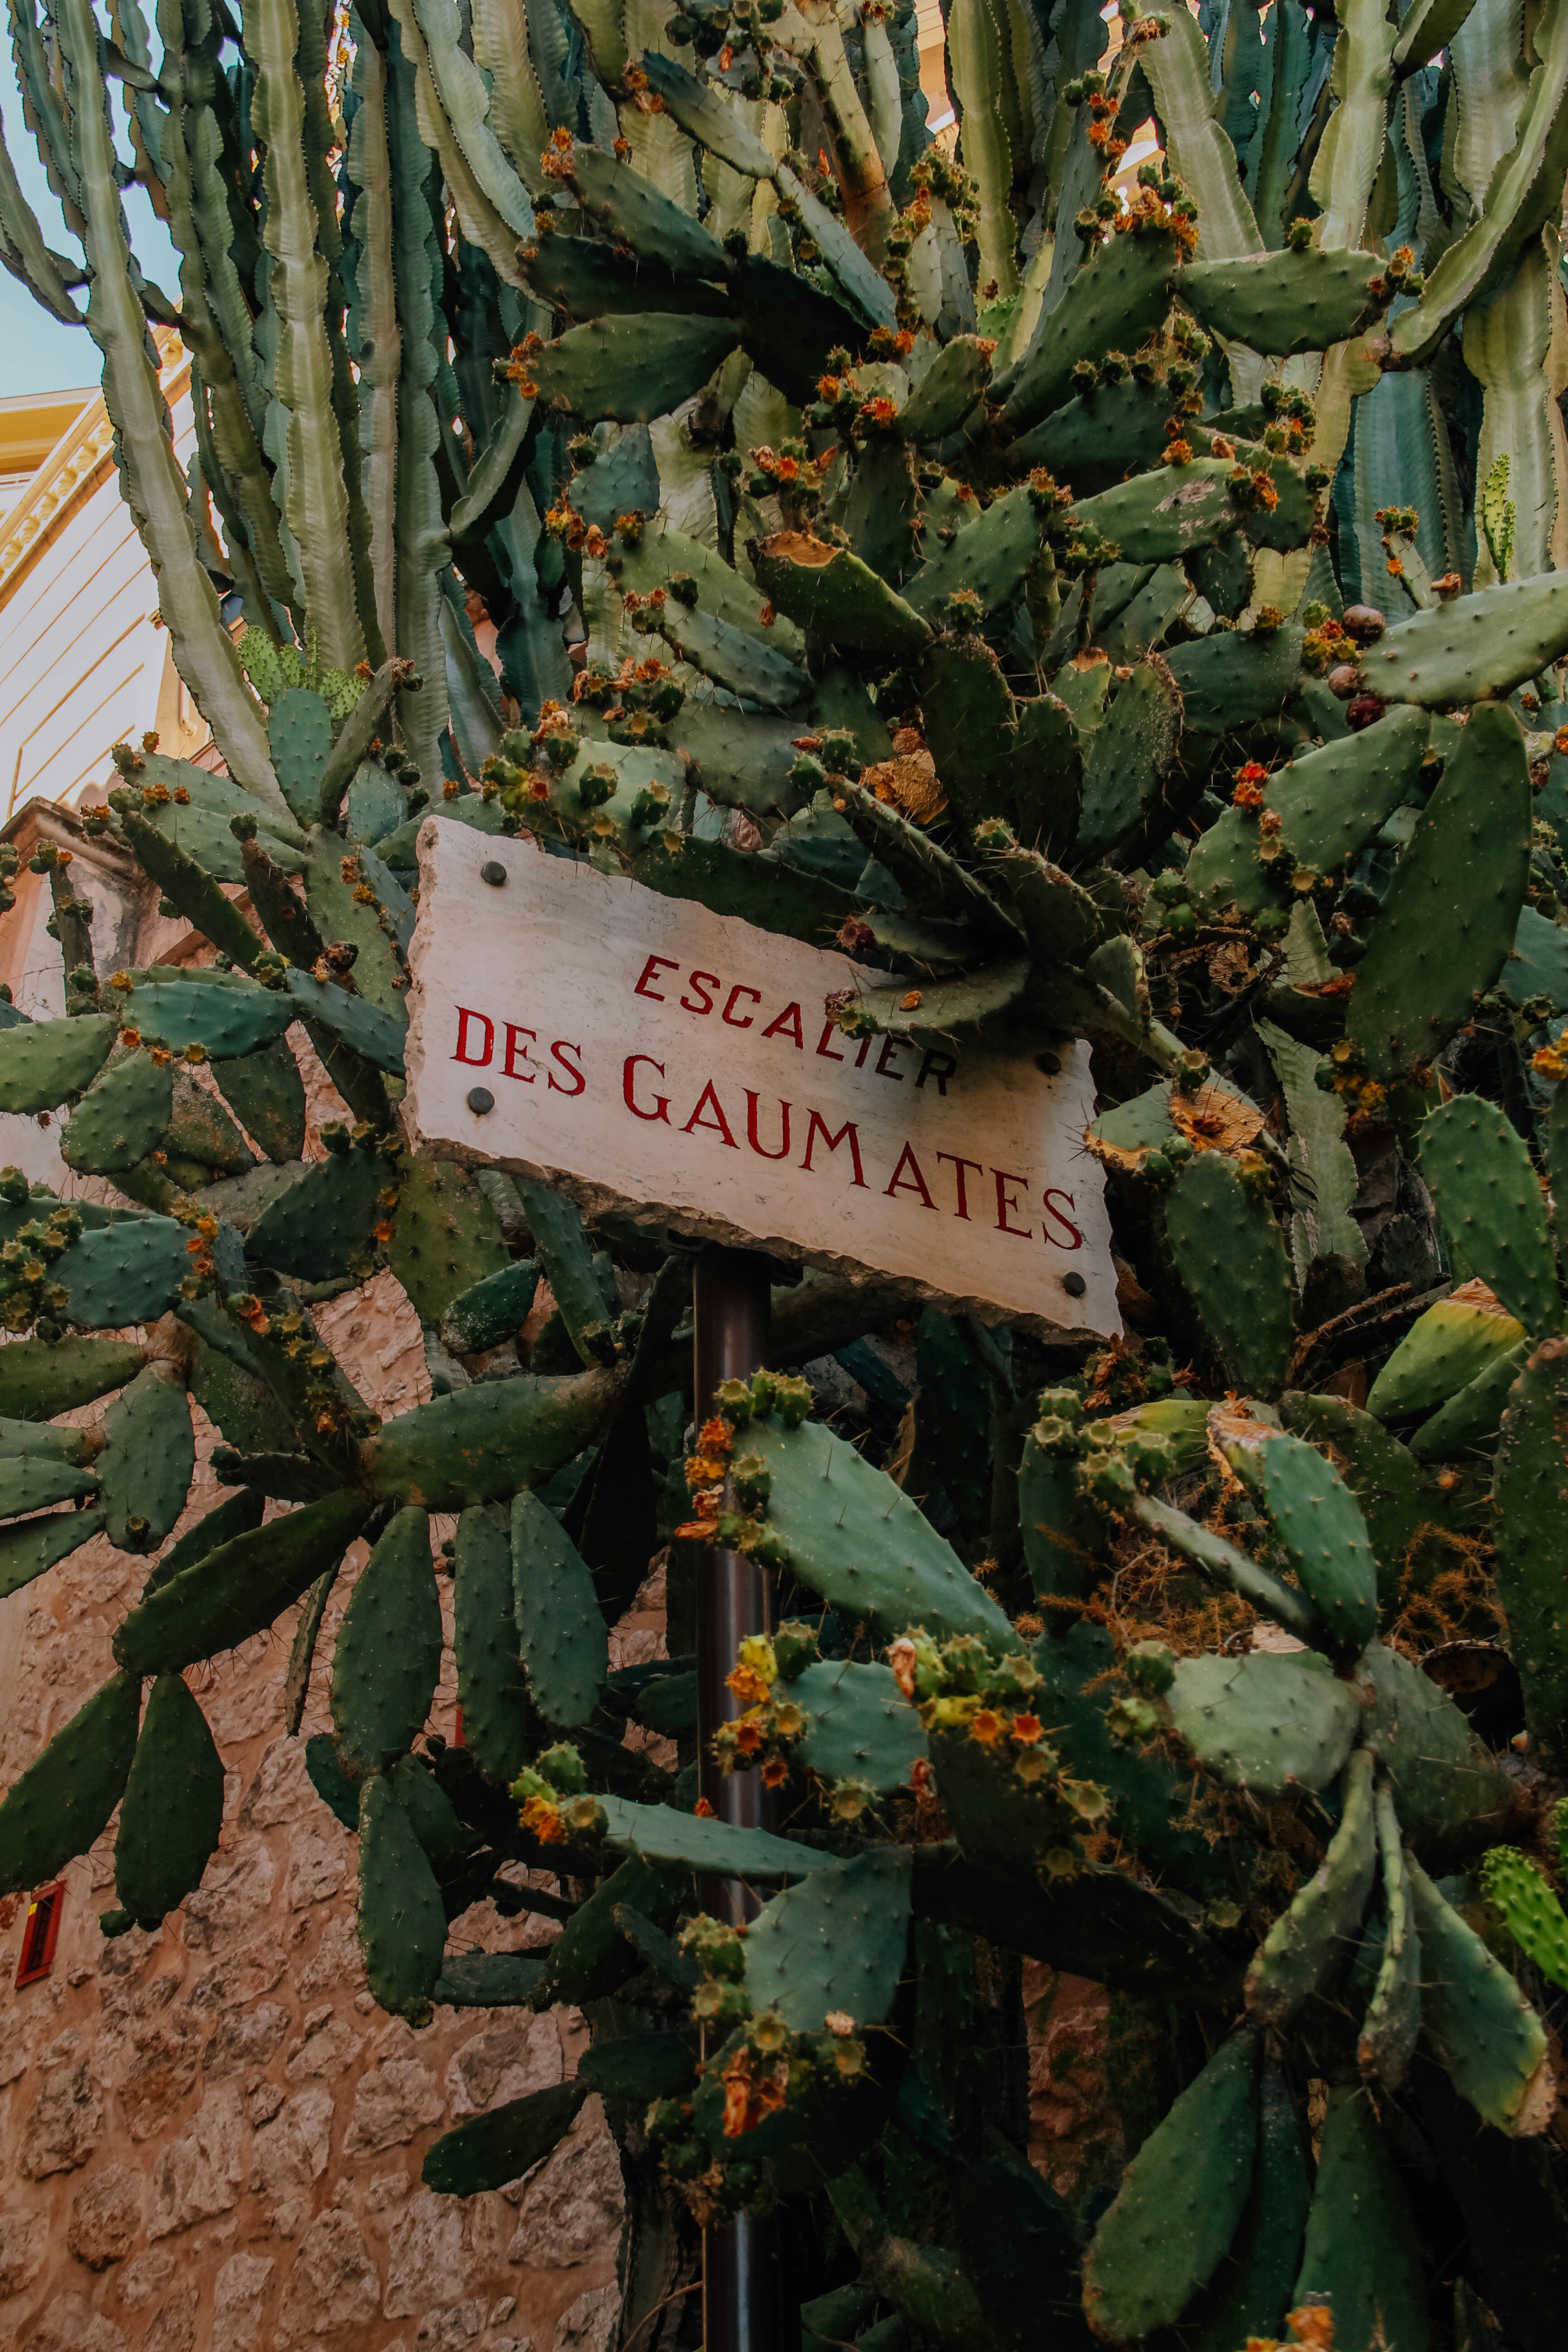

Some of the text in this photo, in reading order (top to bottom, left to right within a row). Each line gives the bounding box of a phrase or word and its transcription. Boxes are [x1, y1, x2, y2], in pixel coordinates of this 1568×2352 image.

[634, 955, 957, 1095] ESCALIER
[451, 1006, 1082, 1250] DES GAUMATES
